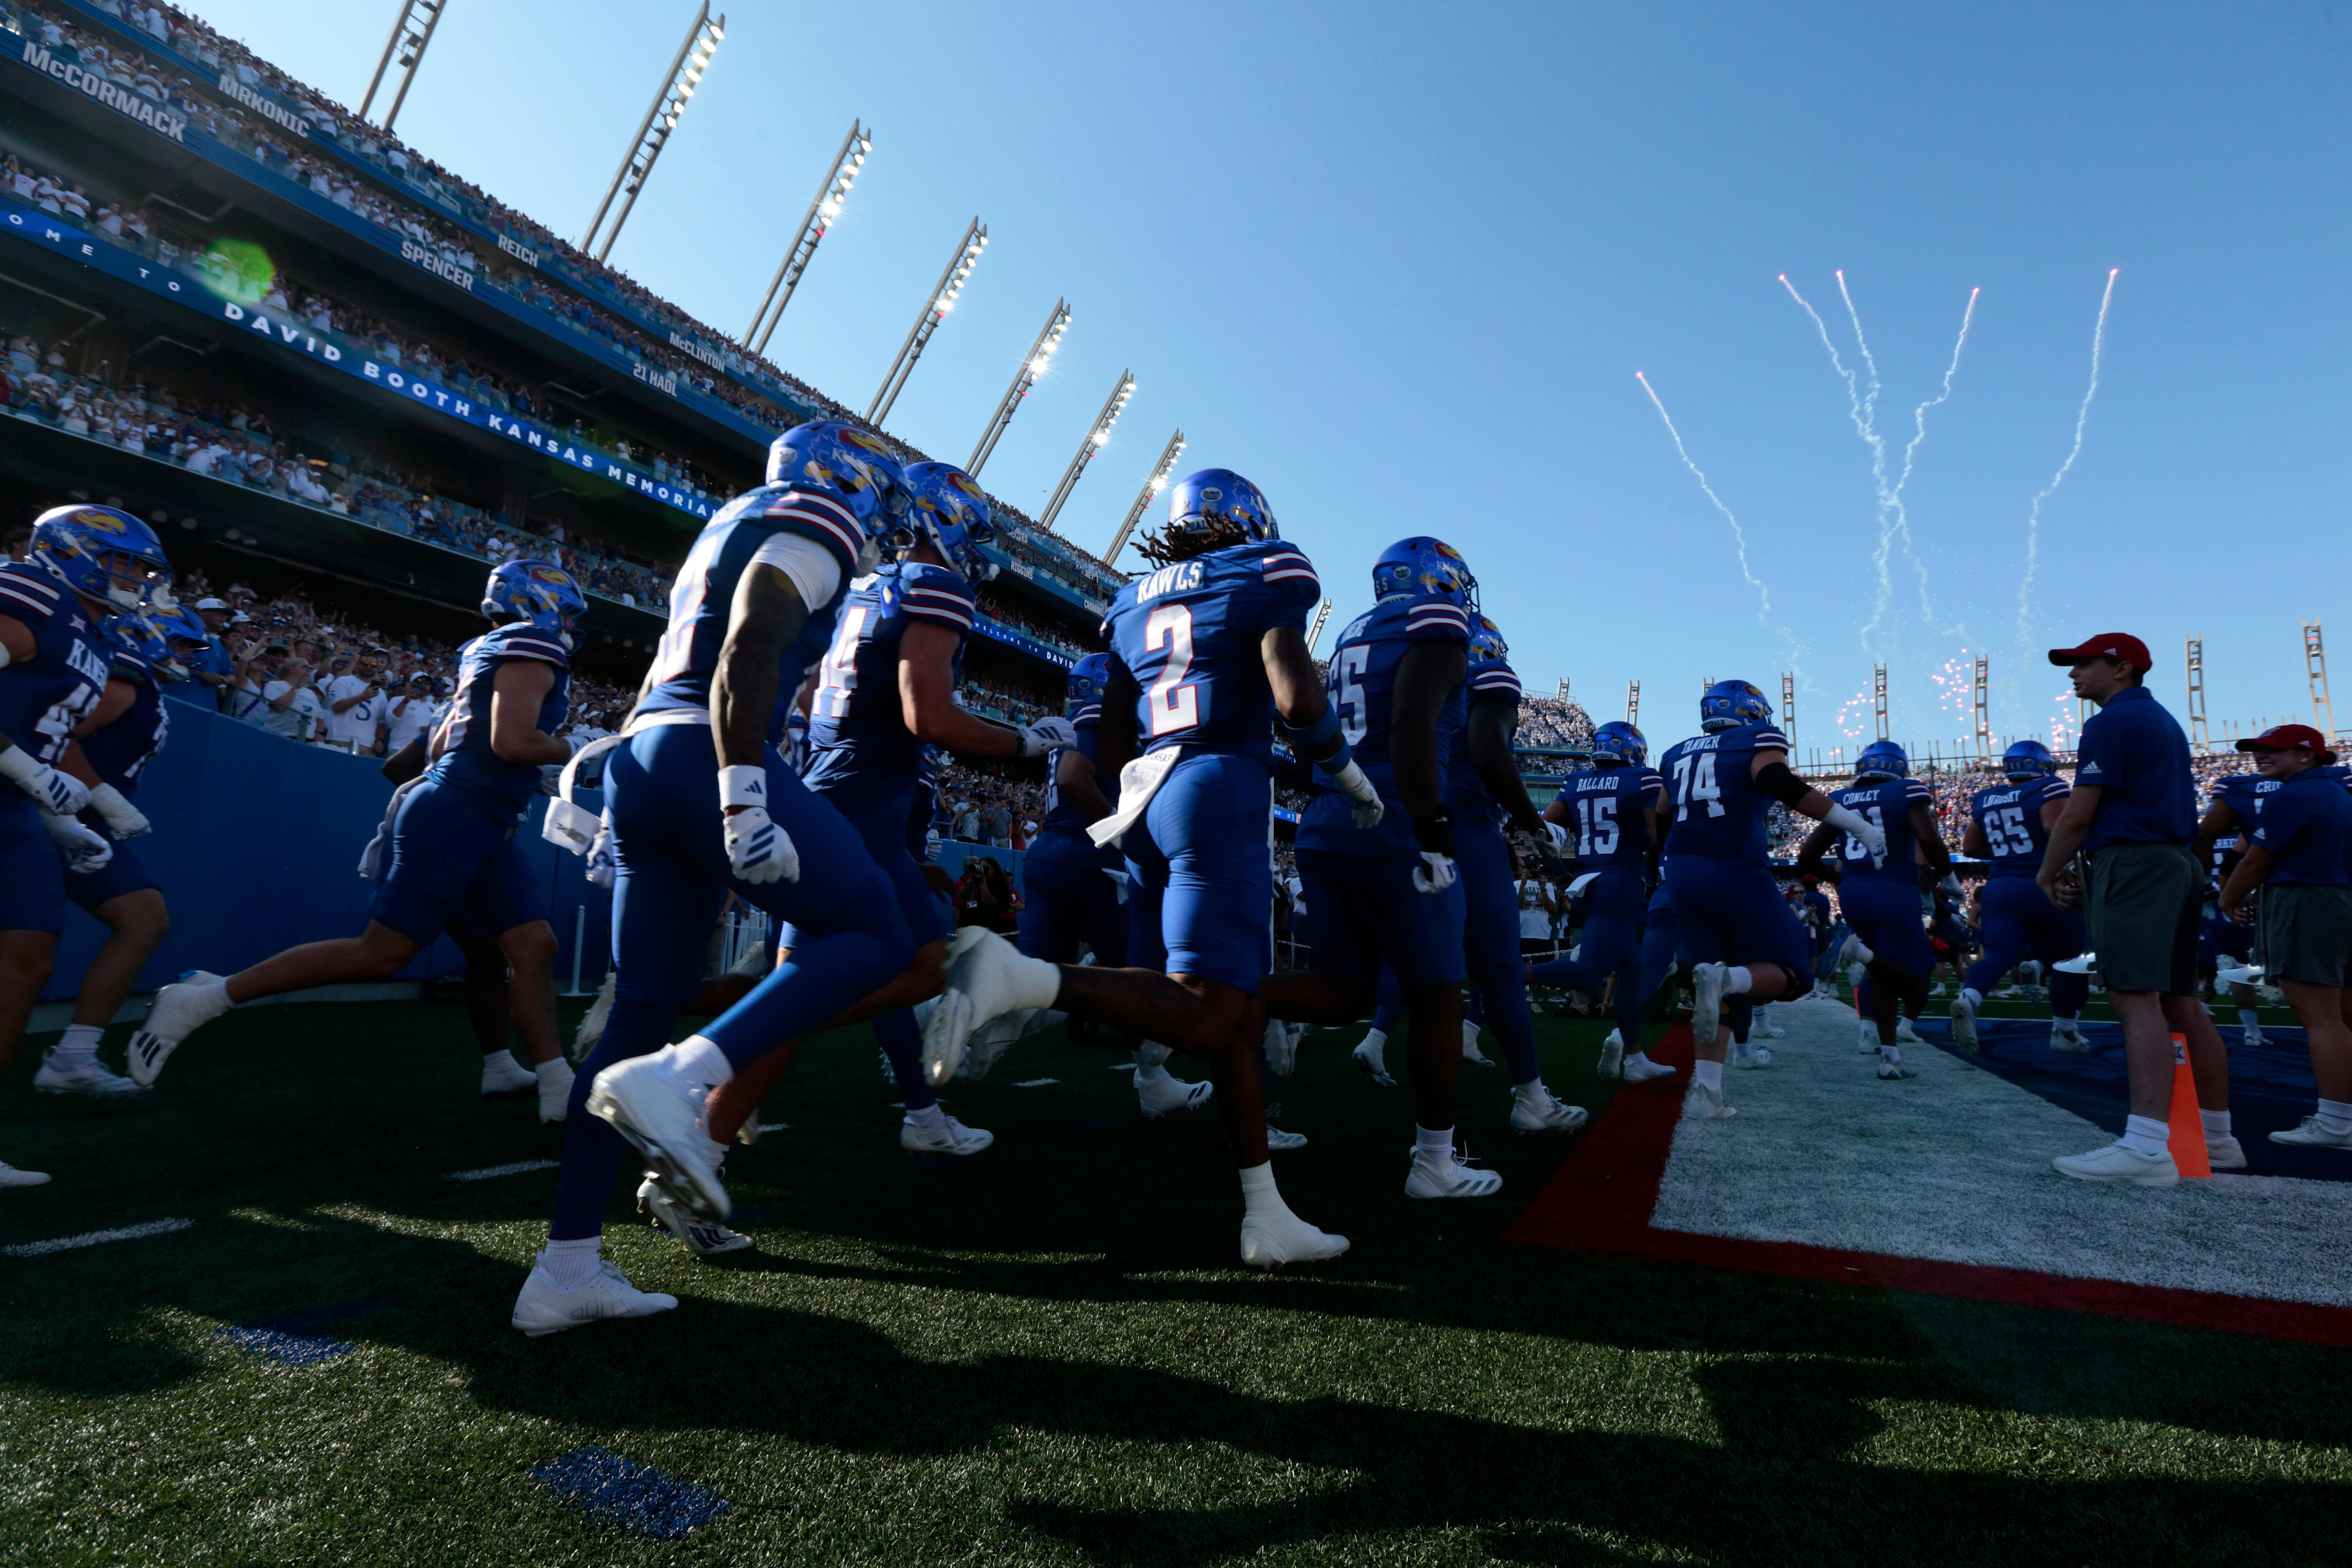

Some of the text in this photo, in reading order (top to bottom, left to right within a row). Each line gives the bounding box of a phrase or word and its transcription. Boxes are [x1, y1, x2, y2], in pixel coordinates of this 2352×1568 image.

[22, 41, 186, 143] McCORMACK
[218, 73, 310, 138] MRKONIC
[401, 240, 474, 292] SPENCER
[497, 233, 539, 268] REICH
[138, 267, 181, 292] TO
[225, 303, 341, 361] DAVID
[363, 361, 470, 417] BOOTH
[488, 414, 593, 468] KANSAS
[633, 362, 647, 382] 21
[669, 331, 725, 374] McCLINTON
[1010, 559, 1033, 580] RIGGINS
[1137, 561, 1204, 604] RAWLS
[975, 621, 1021, 645] WELCOME
[1046, 651, 1074, 669] DAVID
[1146, 602, 1200, 738] 2
[1576, 776, 1619, 792] BALLARD
[1673, 752, 1727, 823] 74
[1843, 789, 1881, 806] CONLEY
[1576, 796, 1620, 856] 15
[1983, 806, 2034, 858] 65
